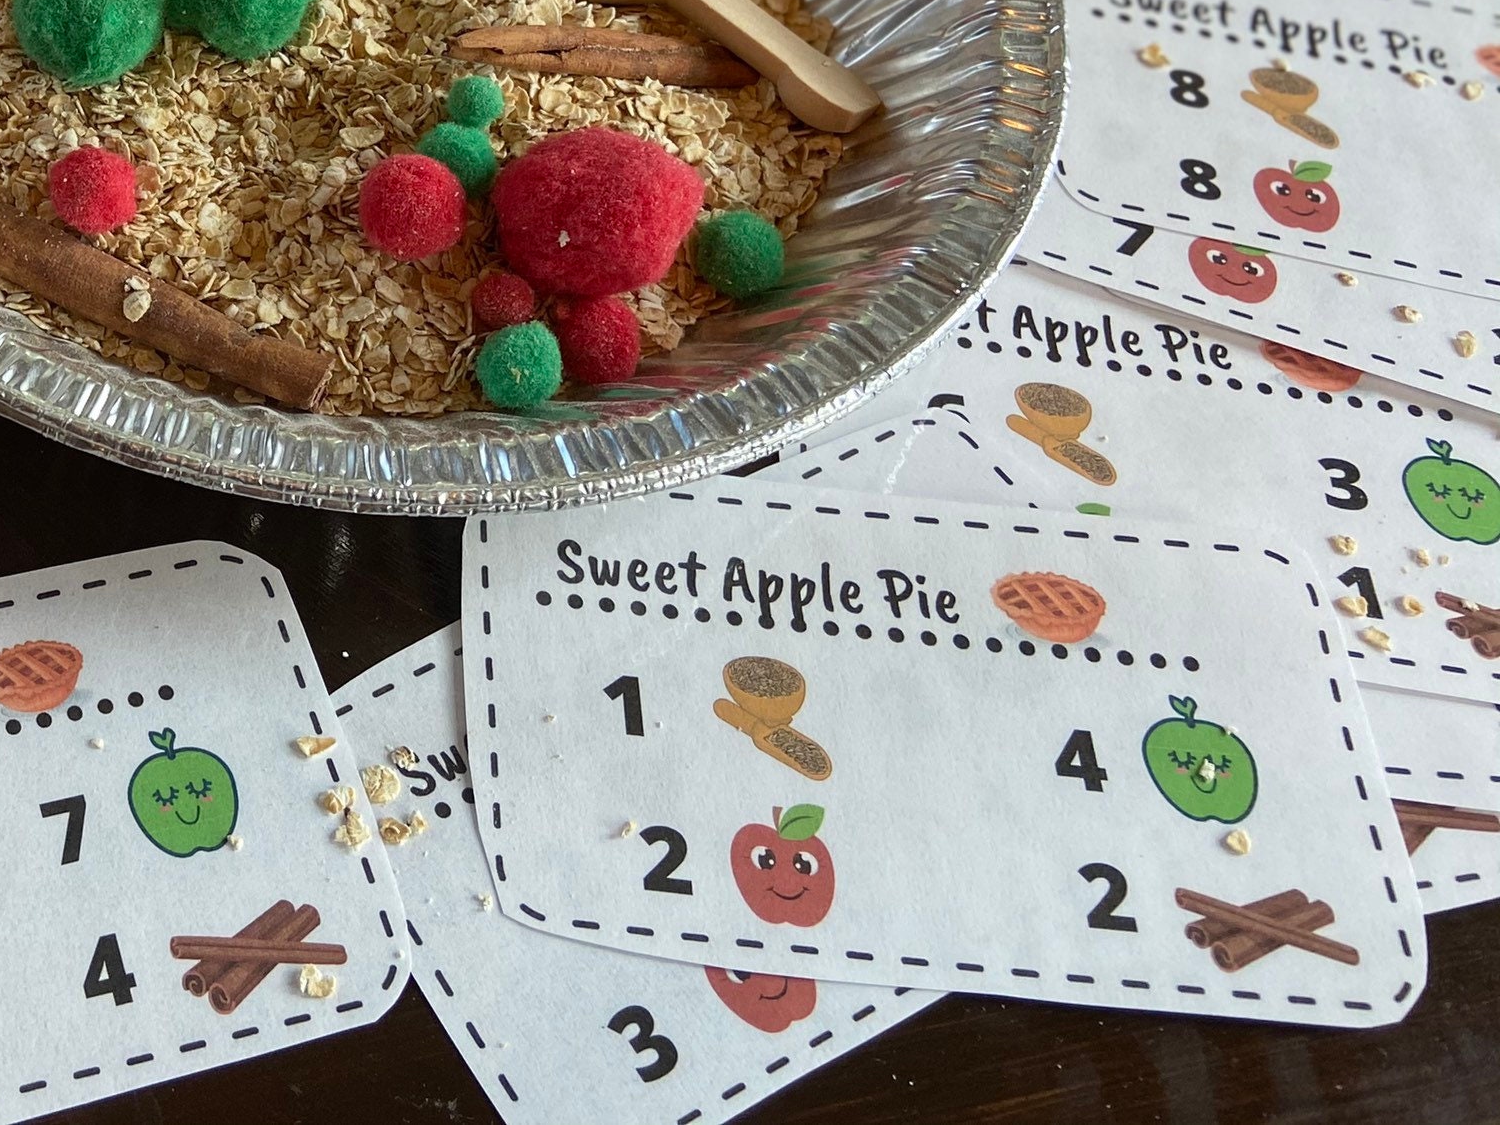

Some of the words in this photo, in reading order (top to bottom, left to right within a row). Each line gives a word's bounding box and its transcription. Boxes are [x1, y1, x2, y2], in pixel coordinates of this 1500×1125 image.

[1250, 7, 1368, 59] Apple
[1380, 28, 1449, 70] Pie
[1169, 69, 1210, 109] 8
[1179, 158, 1222, 201] 8
[1112, 217, 1155, 257] 7
[1012, 304, 1144, 368] Apple
[1154, 323, 1233, 371] Pie
[1317, 457, 1369, 511] 3
[556, 538, 707, 598] Sweet
[722, 561, 864, 633] Apple
[876, 569, 961, 625] Pie
[1336, 566, 1384, 620] 1
[602, 675, 645, 737] 1
[1054, 729, 1109, 793] 4
[39, 794, 87, 866] 7
[639, 825, 694, 896] 2
[1077, 862, 1139, 933] 2
[83, 932, 138, 1007] 4
[606, 1005, 679, 1084] 3
